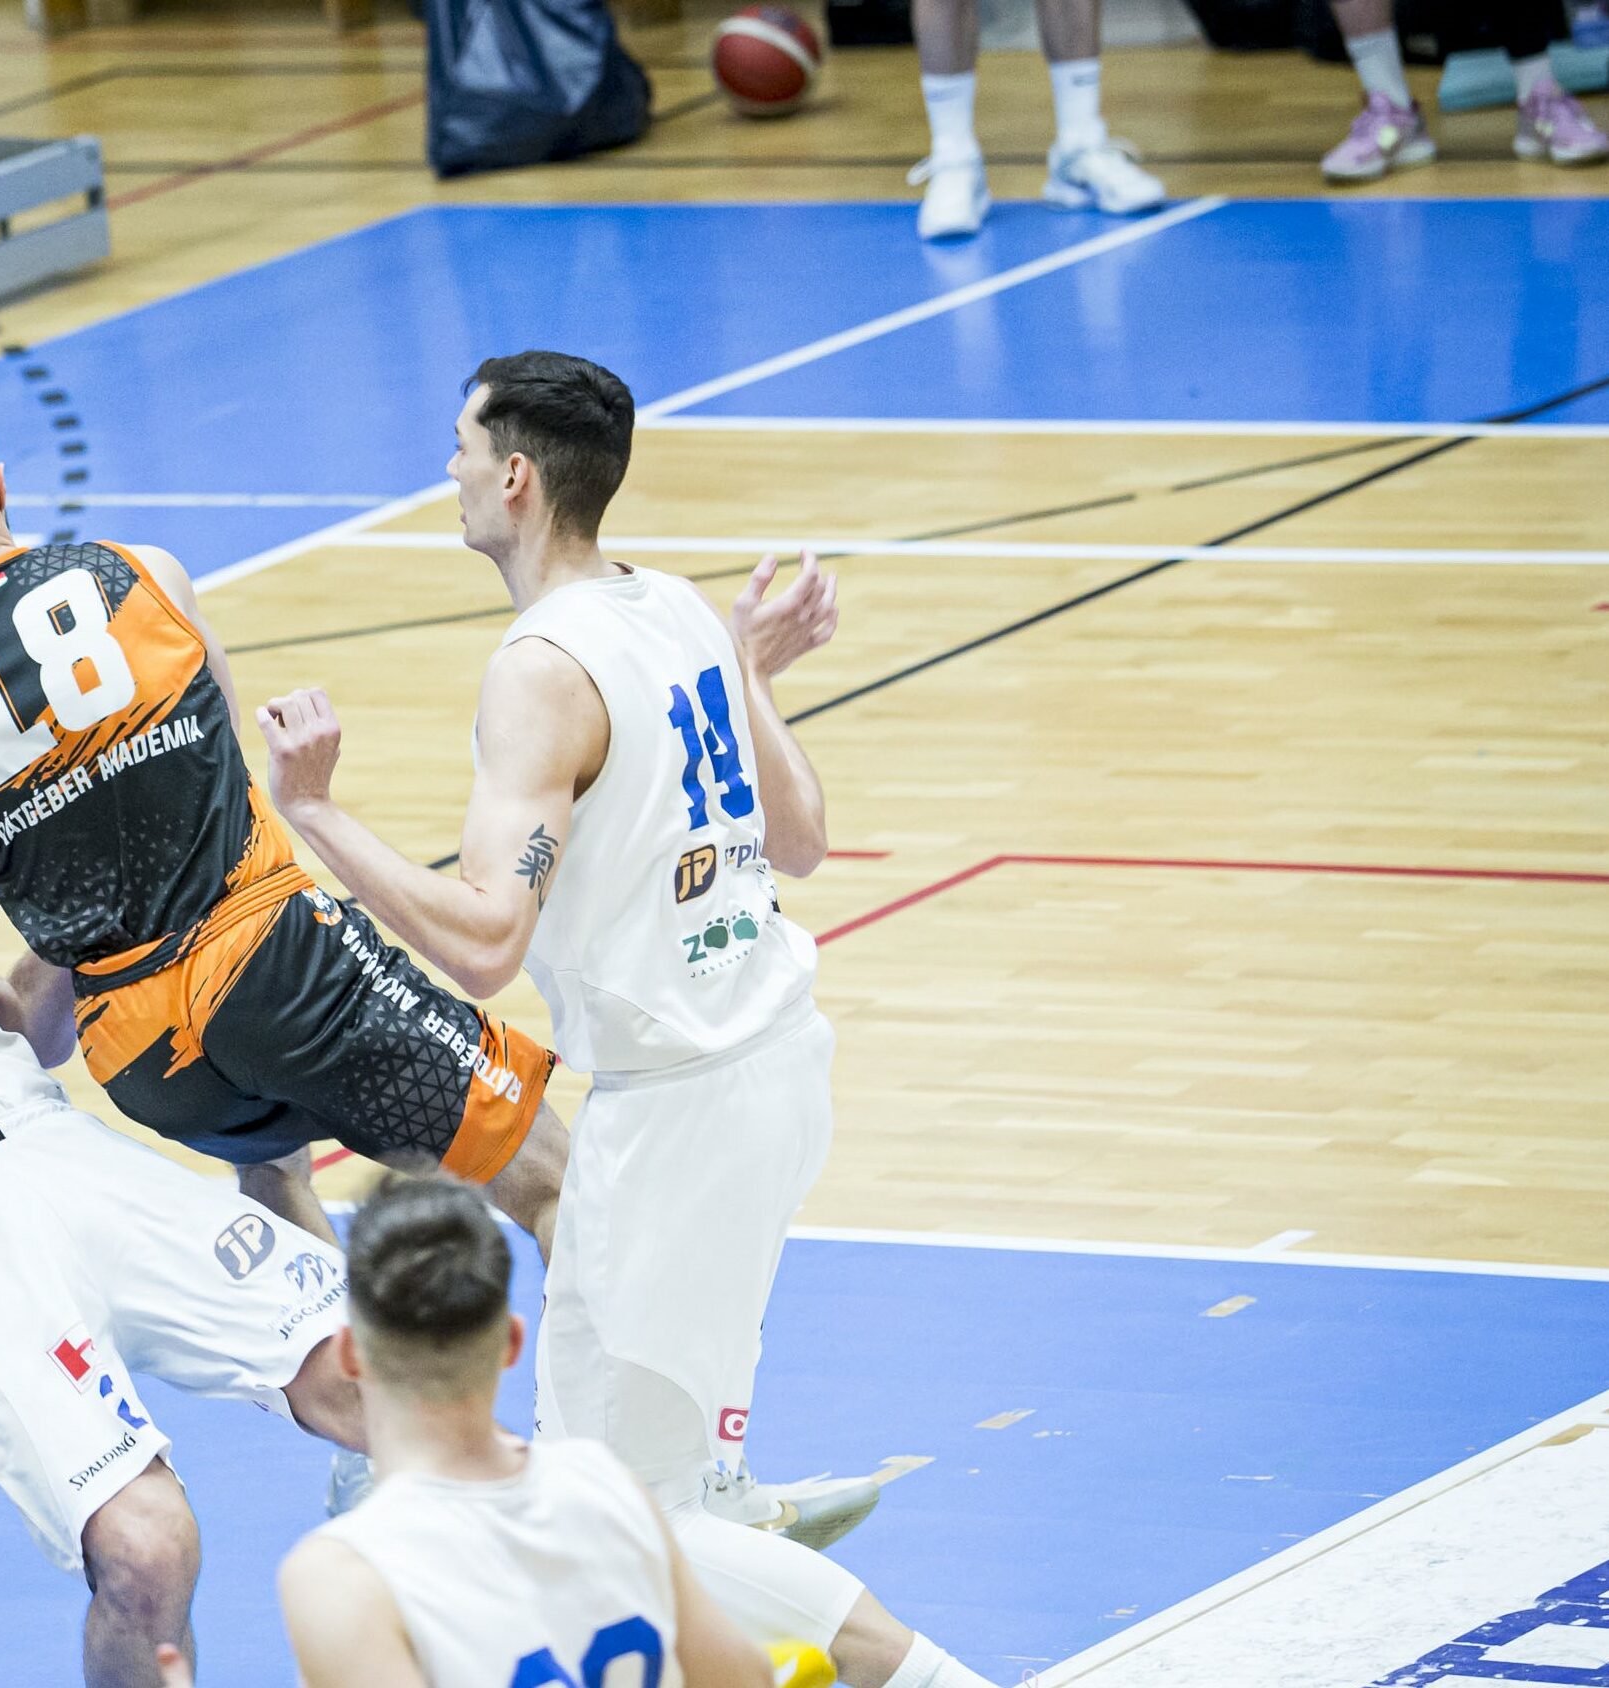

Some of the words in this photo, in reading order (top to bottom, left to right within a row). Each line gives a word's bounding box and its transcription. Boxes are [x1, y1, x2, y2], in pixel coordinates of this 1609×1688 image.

[98, 714, 205, 782] AKADÉMIA
[667, 665, 755, 831] 14
[68, 1431, 137, 1492] SPALDING
